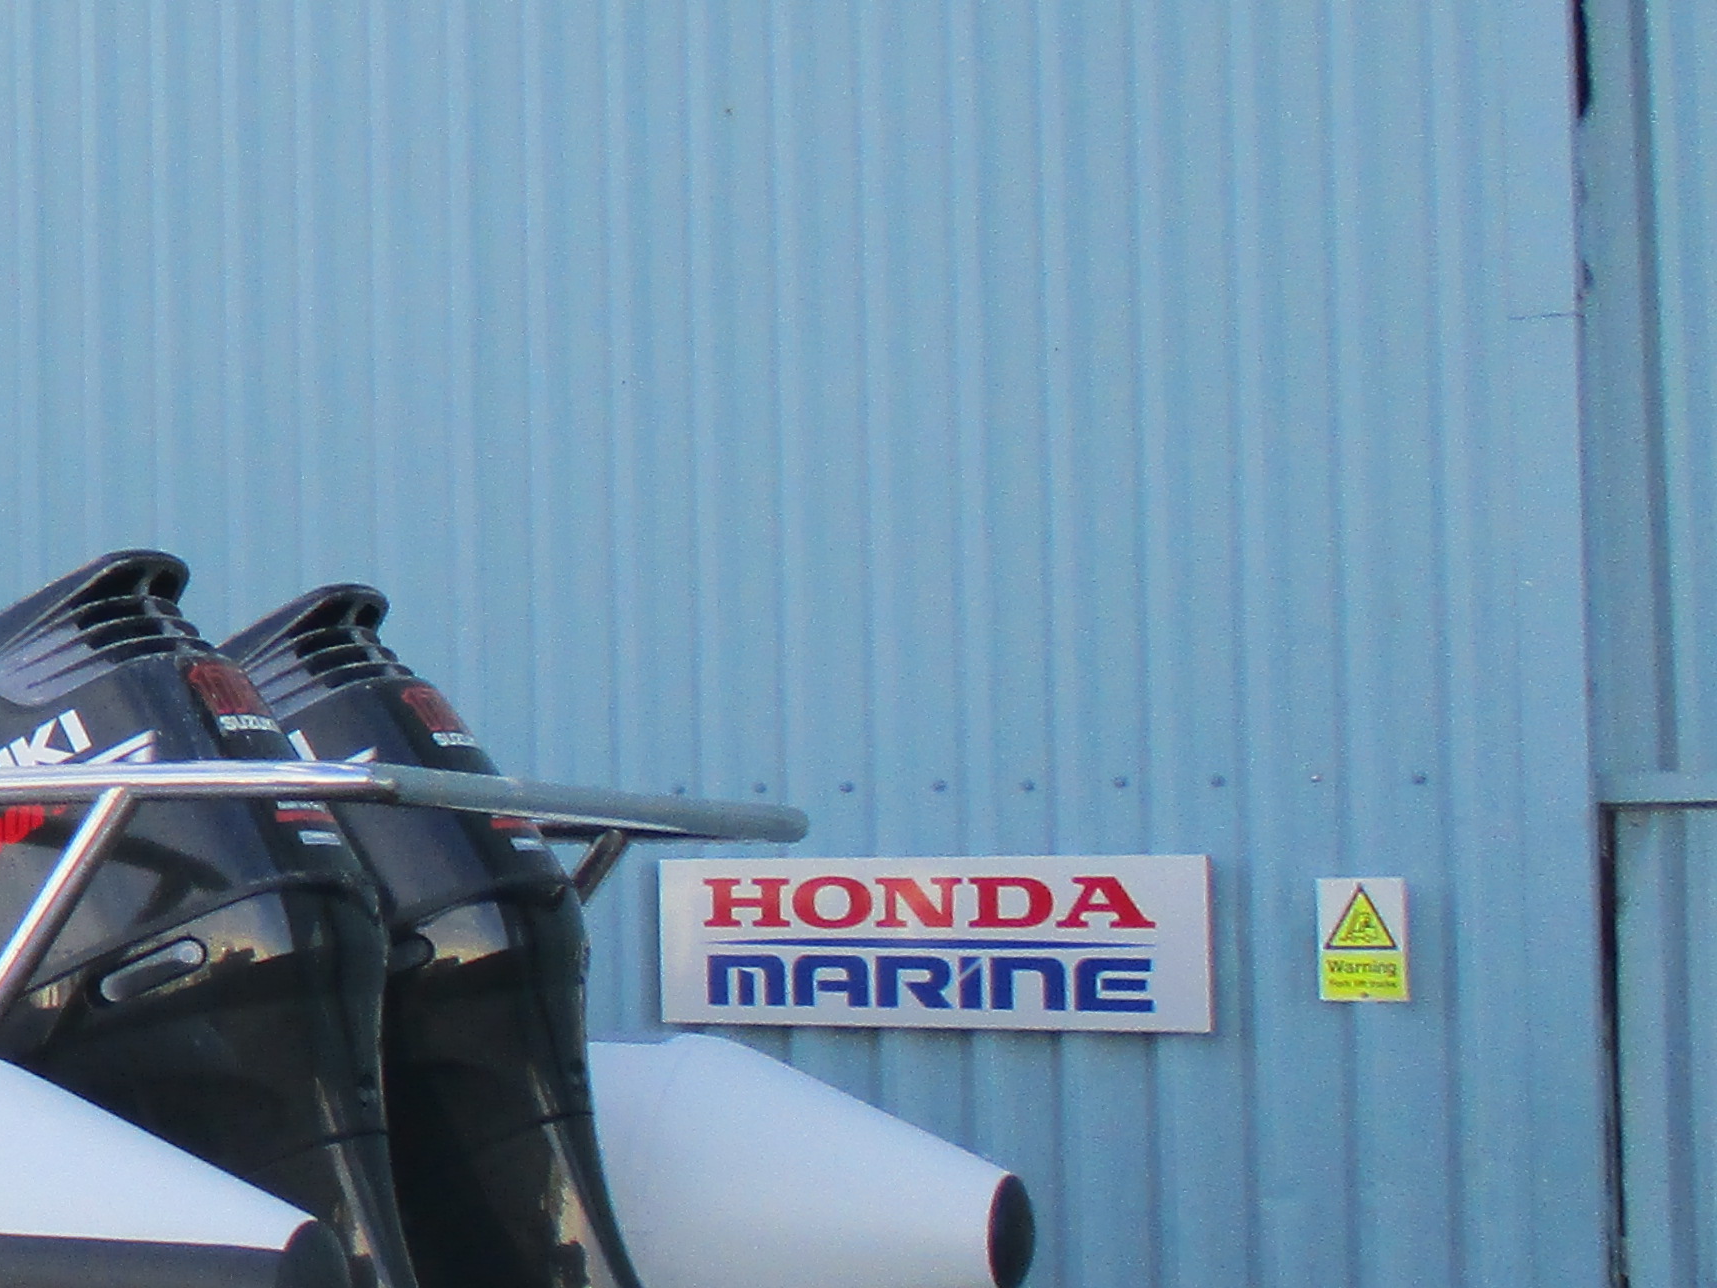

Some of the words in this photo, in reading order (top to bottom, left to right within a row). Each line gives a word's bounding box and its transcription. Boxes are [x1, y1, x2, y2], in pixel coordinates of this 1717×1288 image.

[703, 875, 1156, 930] HONDA
[706, 953, 1155, 1013] MARINE
[1326, 959, 1397, 978] Warning
